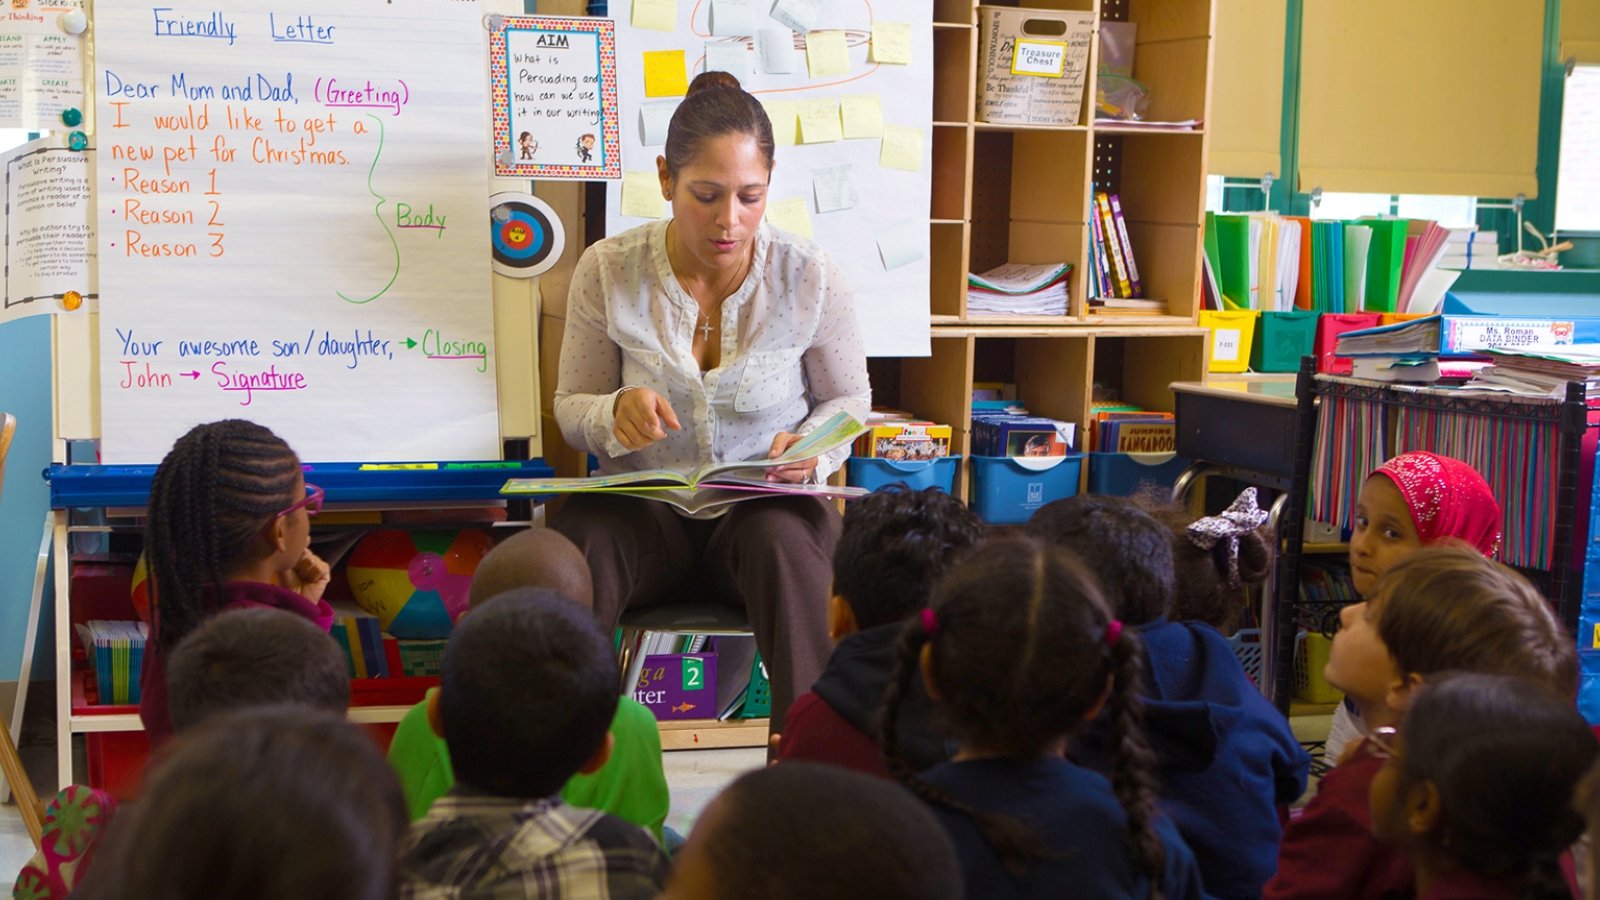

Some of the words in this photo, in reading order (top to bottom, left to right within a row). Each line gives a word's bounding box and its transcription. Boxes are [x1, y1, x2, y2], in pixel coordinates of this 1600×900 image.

[9, 12, 44, 22] Thinking
[153, 8, 238, 46] Friendly
[270, 12, 336, 43] Letter
[536, 34, 569, 48] AIM
[514, 54, 541, 64] What
[549, 55, 559, 65] is
[1021, 47, 1061, 59] Treasure
[1026, 56, 1054, 66] Chest
[519, 69, 577, 92] Persuading
[583, 73, 599, 83] and
[105, 70, 160, 99] Dear
[171, 73, 215, 101] Mom
[221, 76, 253, 102] and
[257, 73, 299, 104] Dad,
[314, 77, 409, 116] (Greeting)
[986, 83, 995, 92] Be
[997, 84, 1029, 93] Thankful
[514, 92, 534, 102] how
[539, 92, 555, 100] can
[579, 92, 595, 101] use
[518, 109, 527, 117] it
[533, 109, 542, 117] in
[546, 109, 561, 118] our
[110, 102, 130, 129] I
[154, 104, 208, 131] would
[228, 106, 263, 132] like
[274, 108, 296, 133] to
[304, 109, 337, 146] get
[353, 118, 368, 134] a
[42, 156, 89, 165] Persuasive
[112, 144, 154, 162] new
[163, 135, 198, 176] pet
[210, 139, 236, 162] for
[252, 139, 350, 166] Christmas.
[33, 165, 67, 175] Writing?
[50, 178, 75, 186] writing
[123, 168, 190, 195] Reason
[203, 168, 222, 195] 1
[124, 199, 193, 225] Reason
[207, 201, 225, 226] 2
[397, 204, 447, 239] Body
[126, 230, 197, 257] Reason
[208, 233, 225, 258] 3
[1479, 334, 1503, 342] DATA
[1505, 335, 1539, 343] BINDER
[1504, 327, 1534, 336] Roman
[115, 328, 163, 357] Your
[179, 338, 260, 357] awesome
[422, 329, 488, 373] Closing
[120, 361, 172, 389] John
[211, 361, 307, 406] Signature
[687, 667, 699, 686] 2
